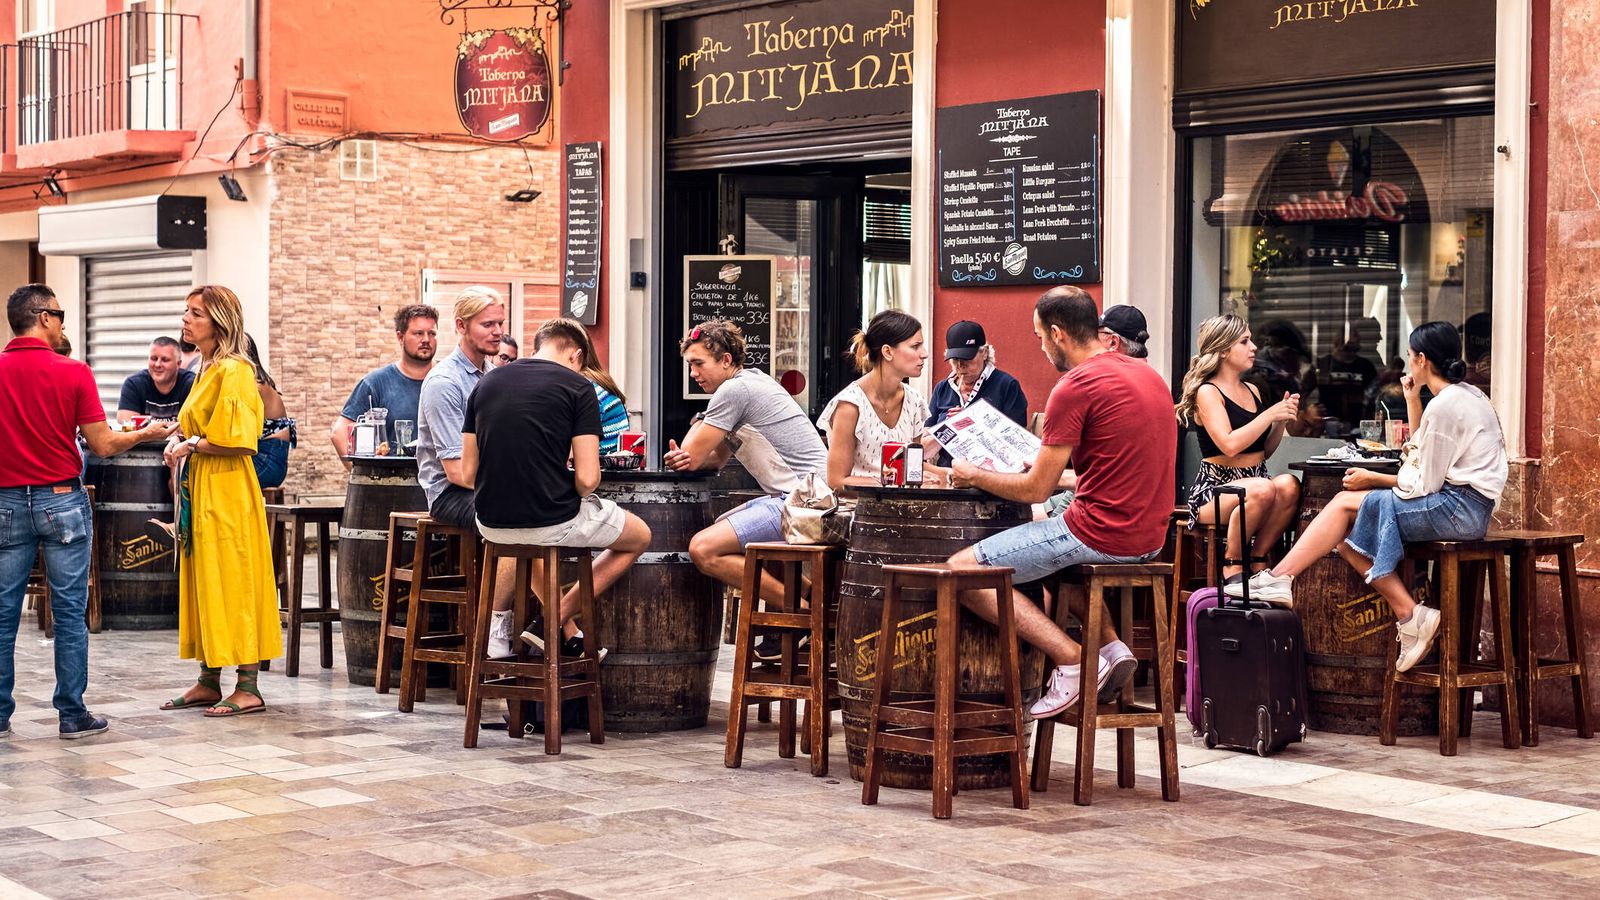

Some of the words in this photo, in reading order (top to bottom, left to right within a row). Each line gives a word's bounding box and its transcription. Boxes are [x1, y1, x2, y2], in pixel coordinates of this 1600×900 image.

[744, 16, 854, 59] Taberna
[478, 67, 526, 84] Taberna
[685, 50, 914, 119] MITJANA
[996, 107, 1031, 120] Taberna
[1003, 146, 1021, 157] TAPE
[575, 168, 593, 176] TAPAS
[1041, 162, 1055, 171] salad
[976, 181, 995, 192] Peppers
[1022, 177, 1036, 187] Little
[1041, 190, 1056, 200] salad
[1022, 205, 1034, 214] Lean
[1034, 204, 1047, 214] Pork
[1046, 203, 1058, 213] with
[1057, 202, 1076, 212] Tomato
[1022, 219, 1035, 228] Lean
[1034, 218, 1047, 228] Pork
[950, 254, 975, 265] Paella
[975, 252, 992, 266] 5,50
[993, 252, 1001, 263] €
[727, 293, 738, 301] DE
